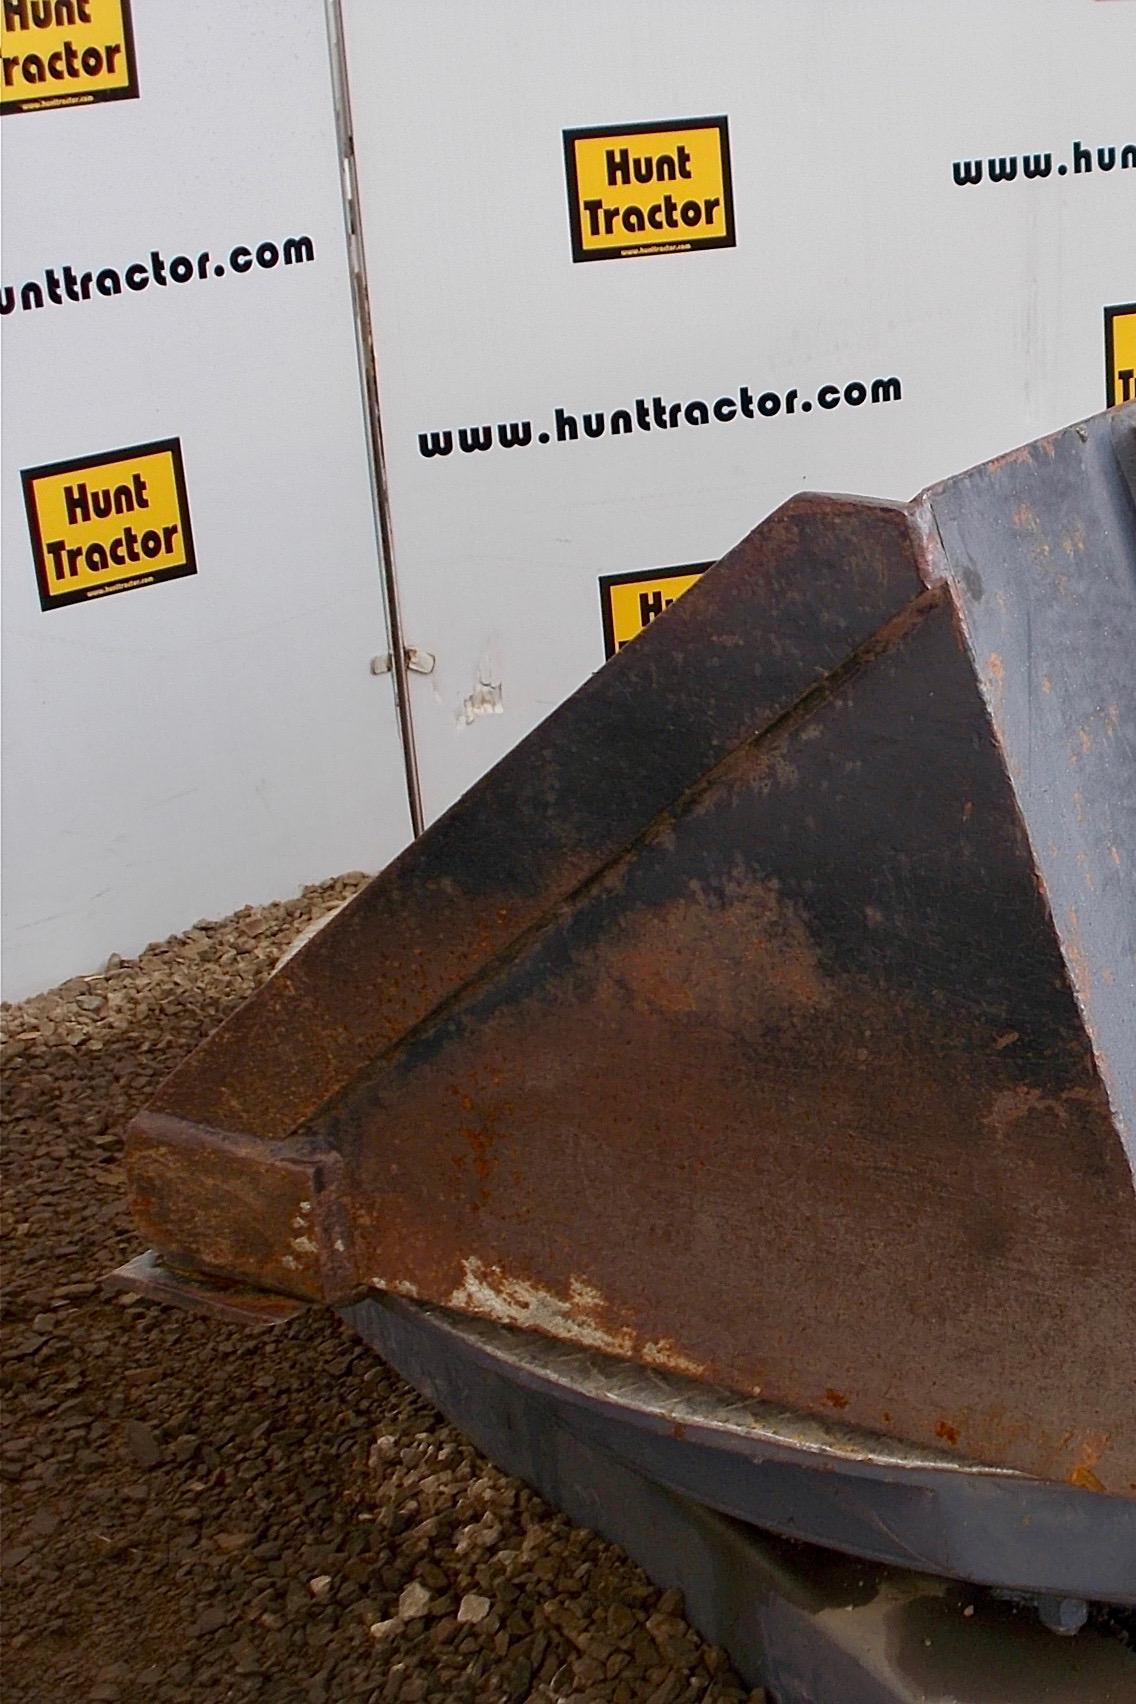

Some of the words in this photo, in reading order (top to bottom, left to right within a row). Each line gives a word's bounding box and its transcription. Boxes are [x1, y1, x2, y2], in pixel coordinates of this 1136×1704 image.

[3, 0, 91, 32] Hunt
[0, 41, 121, 87] ractor
[605, 145, 692, 186] Hunt
[583, 194, 721, 236] Tractor
[418, 376, 902, 458] www.hunttractor.com
[64, 473, 149, 525] Hunt
[46, 524, 178, 581] Tractor
